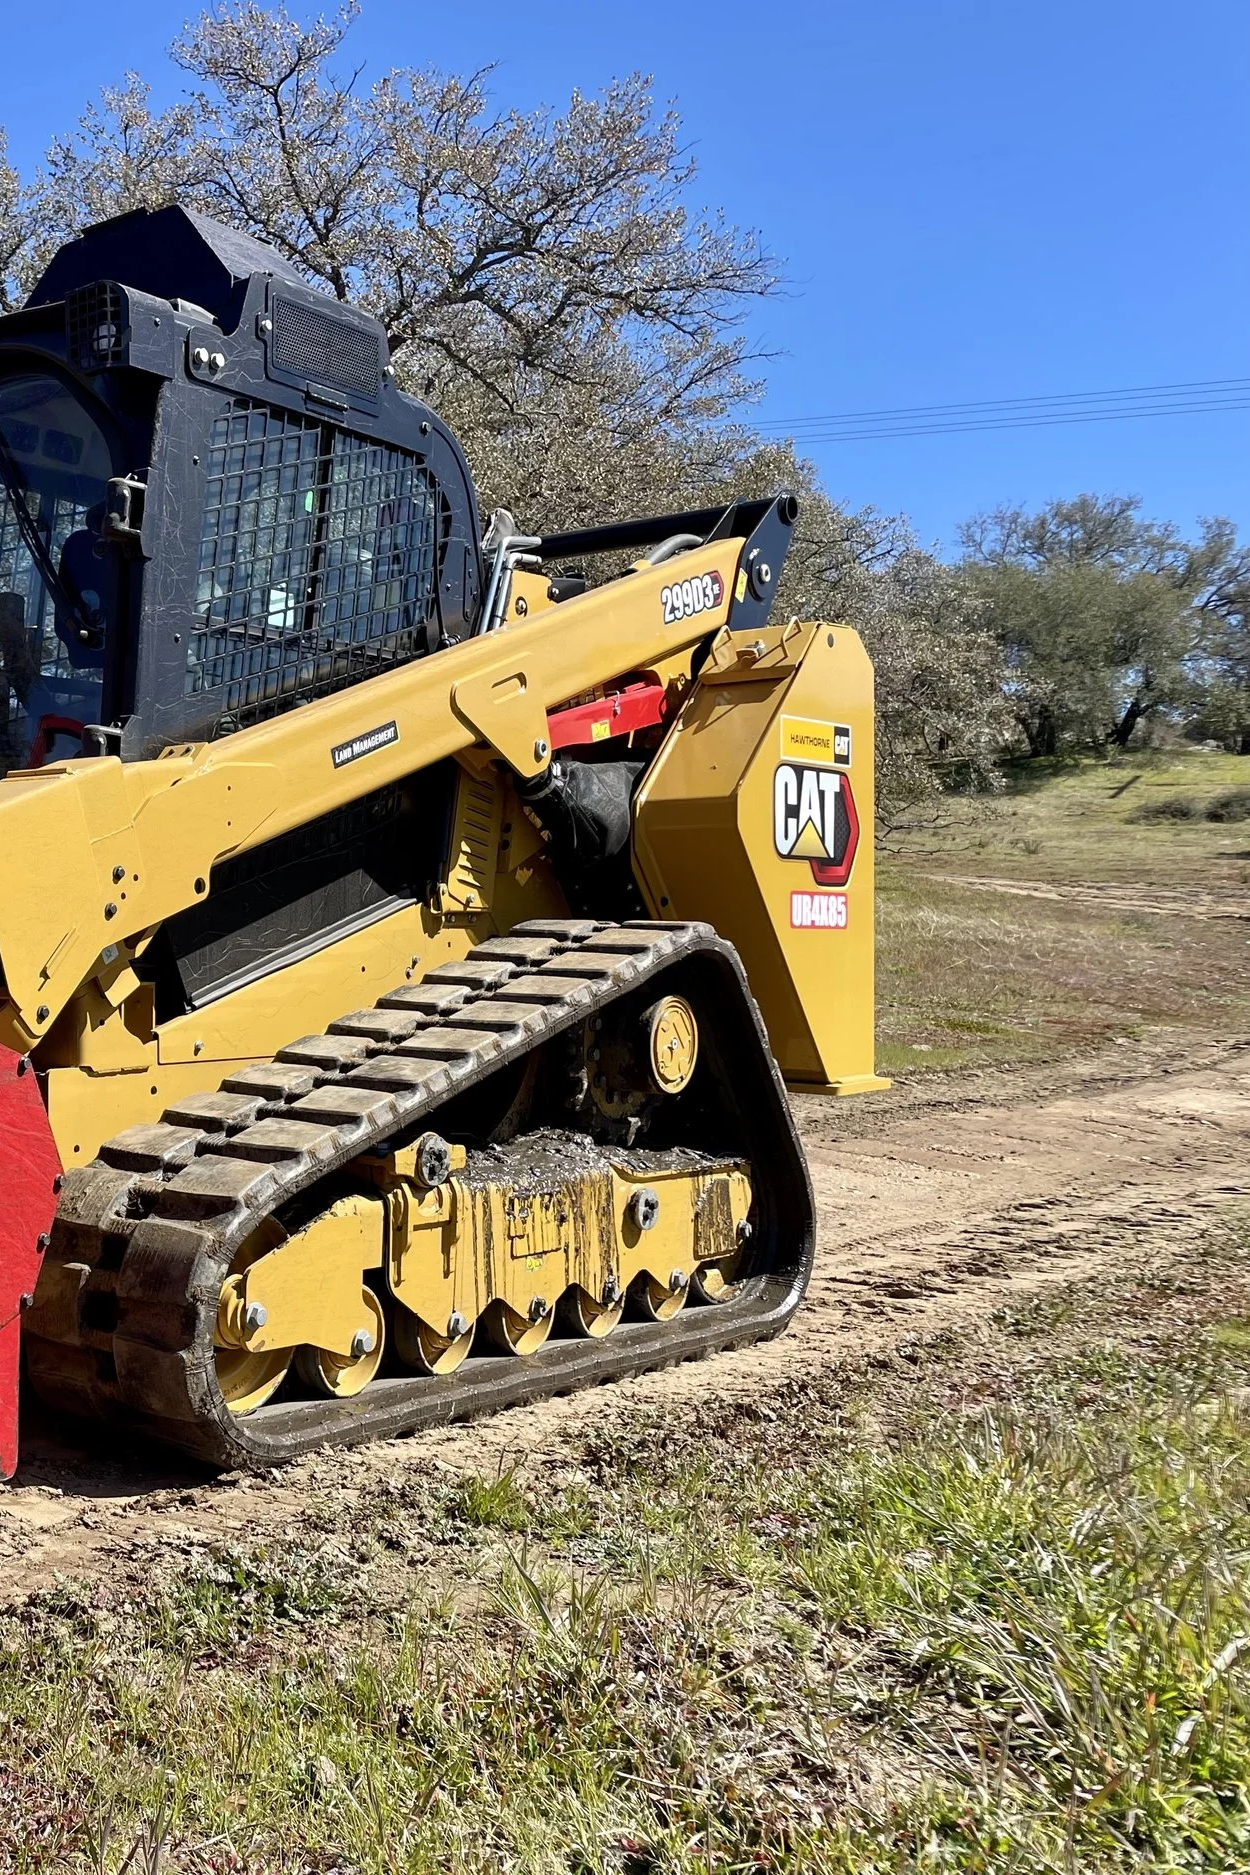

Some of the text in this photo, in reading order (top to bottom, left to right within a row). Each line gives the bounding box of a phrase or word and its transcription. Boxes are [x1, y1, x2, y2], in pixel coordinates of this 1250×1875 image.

[661, 575, 714, 622] 299D3
[335, 727, 395, 763] LAND MANAGEMENT
[790, 733, 830, 749] HAWTHORNE
[774, 765, 841, 859] CAT
[791, 894, 847, 928] UR4X85
